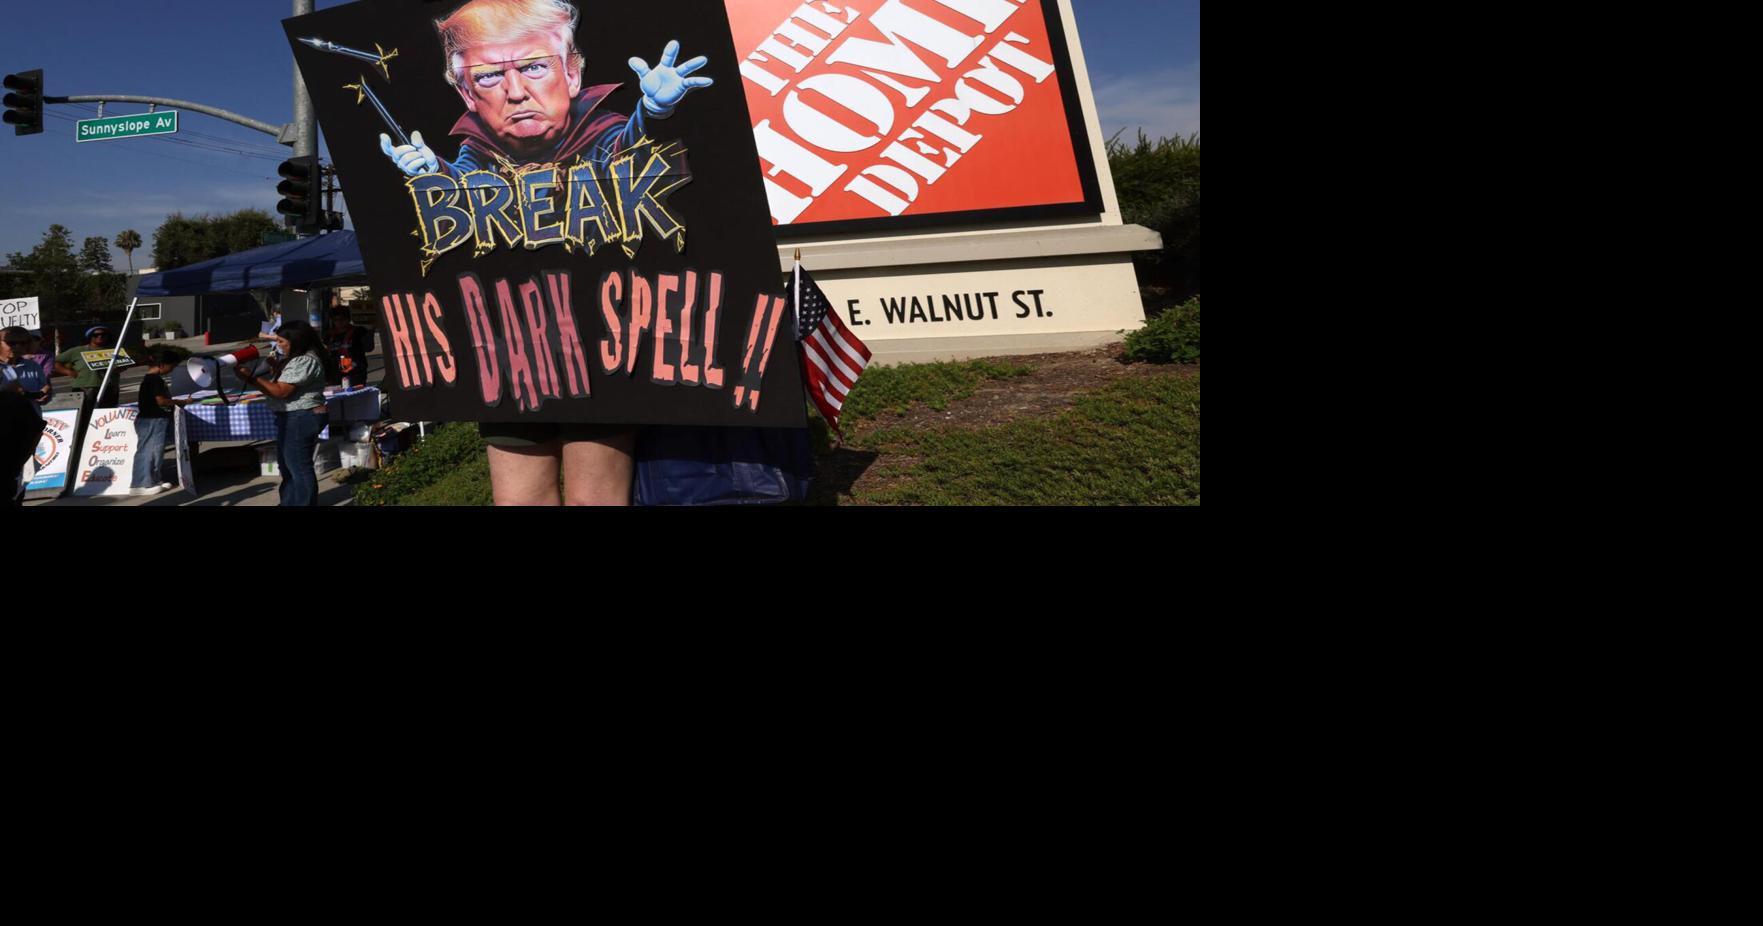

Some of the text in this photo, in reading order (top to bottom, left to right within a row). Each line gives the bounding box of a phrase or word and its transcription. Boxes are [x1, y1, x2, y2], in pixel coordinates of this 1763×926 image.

[739, 0, 861, 96] THE
[81, 117, 172, 135] Sunnyslope Av
[843, 31, 1055, 216] DEPOT
[405, 150, 690, 258] BREAK
[847, 289, 1054, 326] E. WALNUT ST.
[382, 292, 457, 387] HIS
[458, 272, 592, 412] DARK
[600, 270, 725, 386] SPELL
[91, 440, 128, 454] Support
[104, 428, 127, 440] Learn
[88, 455, 125, 468] Organize
